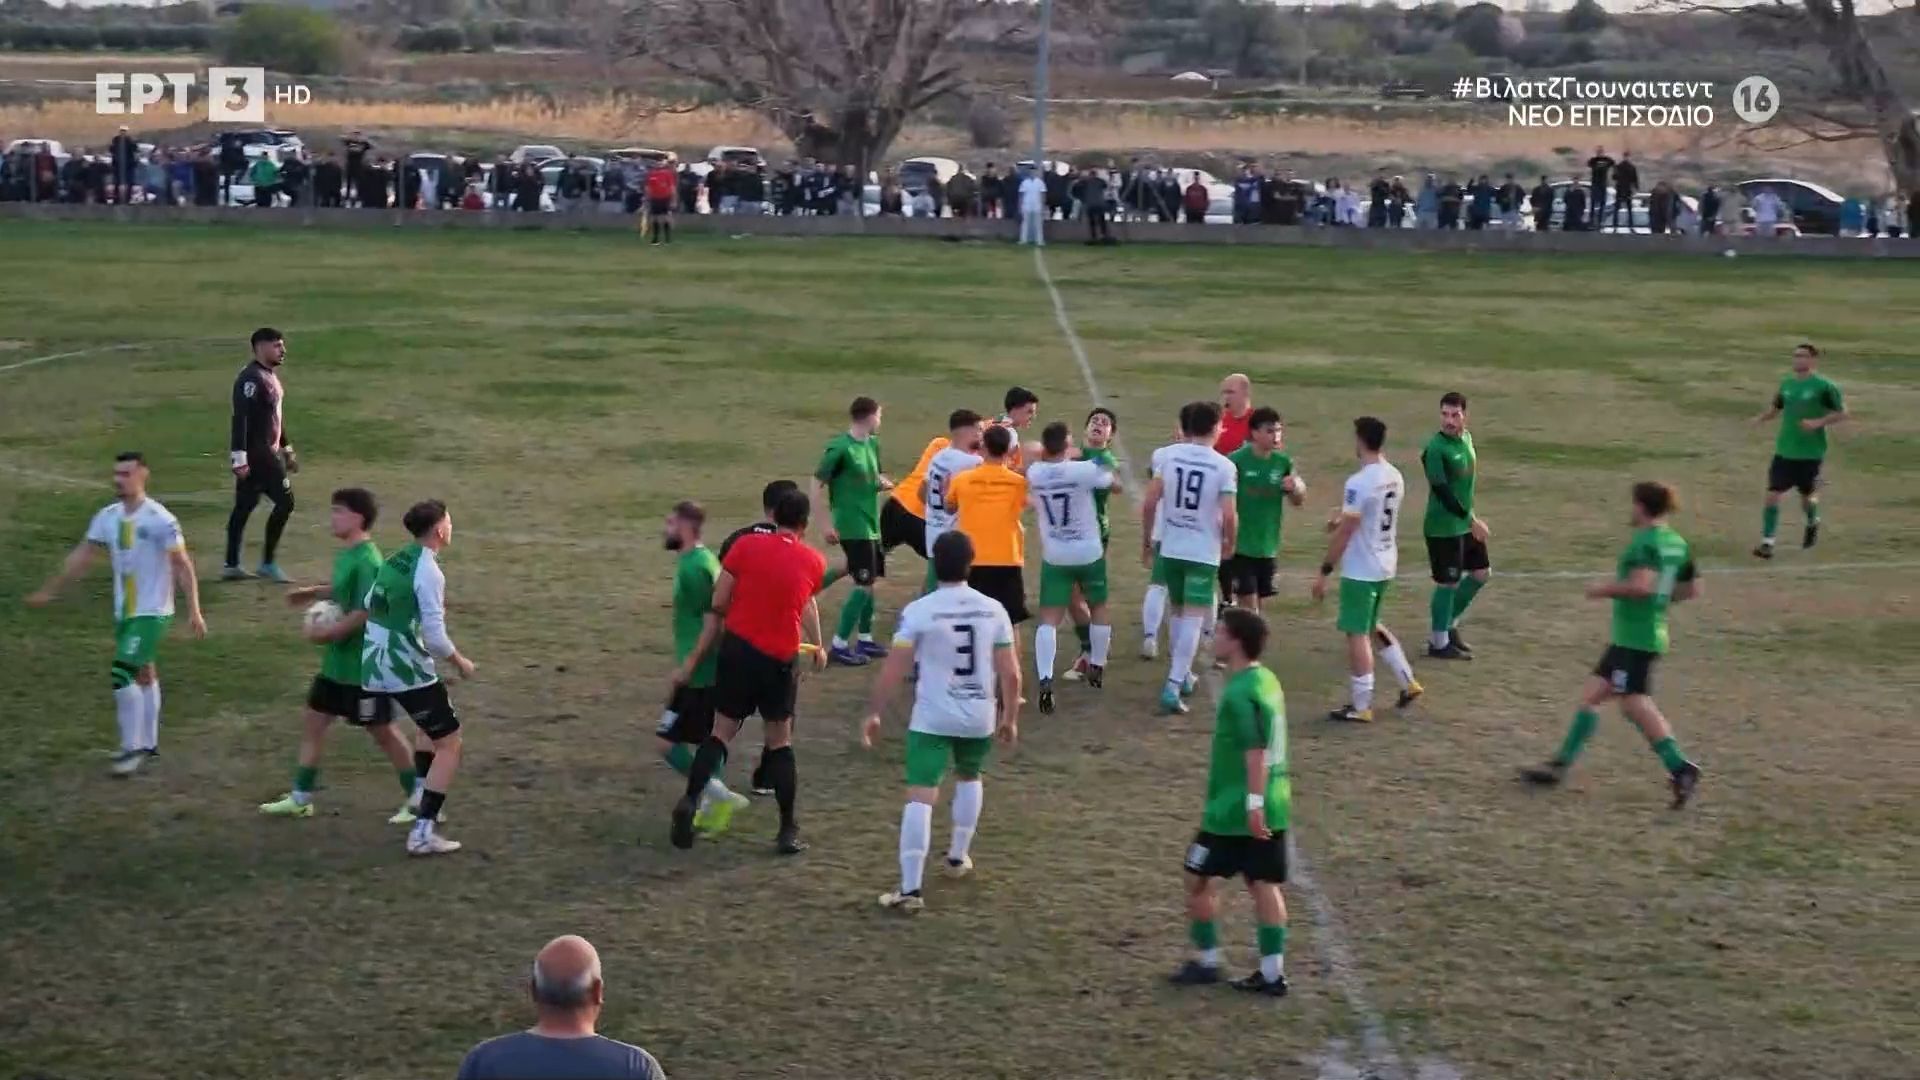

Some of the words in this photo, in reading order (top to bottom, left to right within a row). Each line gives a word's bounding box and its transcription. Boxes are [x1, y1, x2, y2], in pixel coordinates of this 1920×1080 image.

[1039, 492, 1070, 527] 17
[1174, 467, 1205, 511] 19
[1380, 491, 1398, 532] 5
[952, 624, 975, 676] 3
